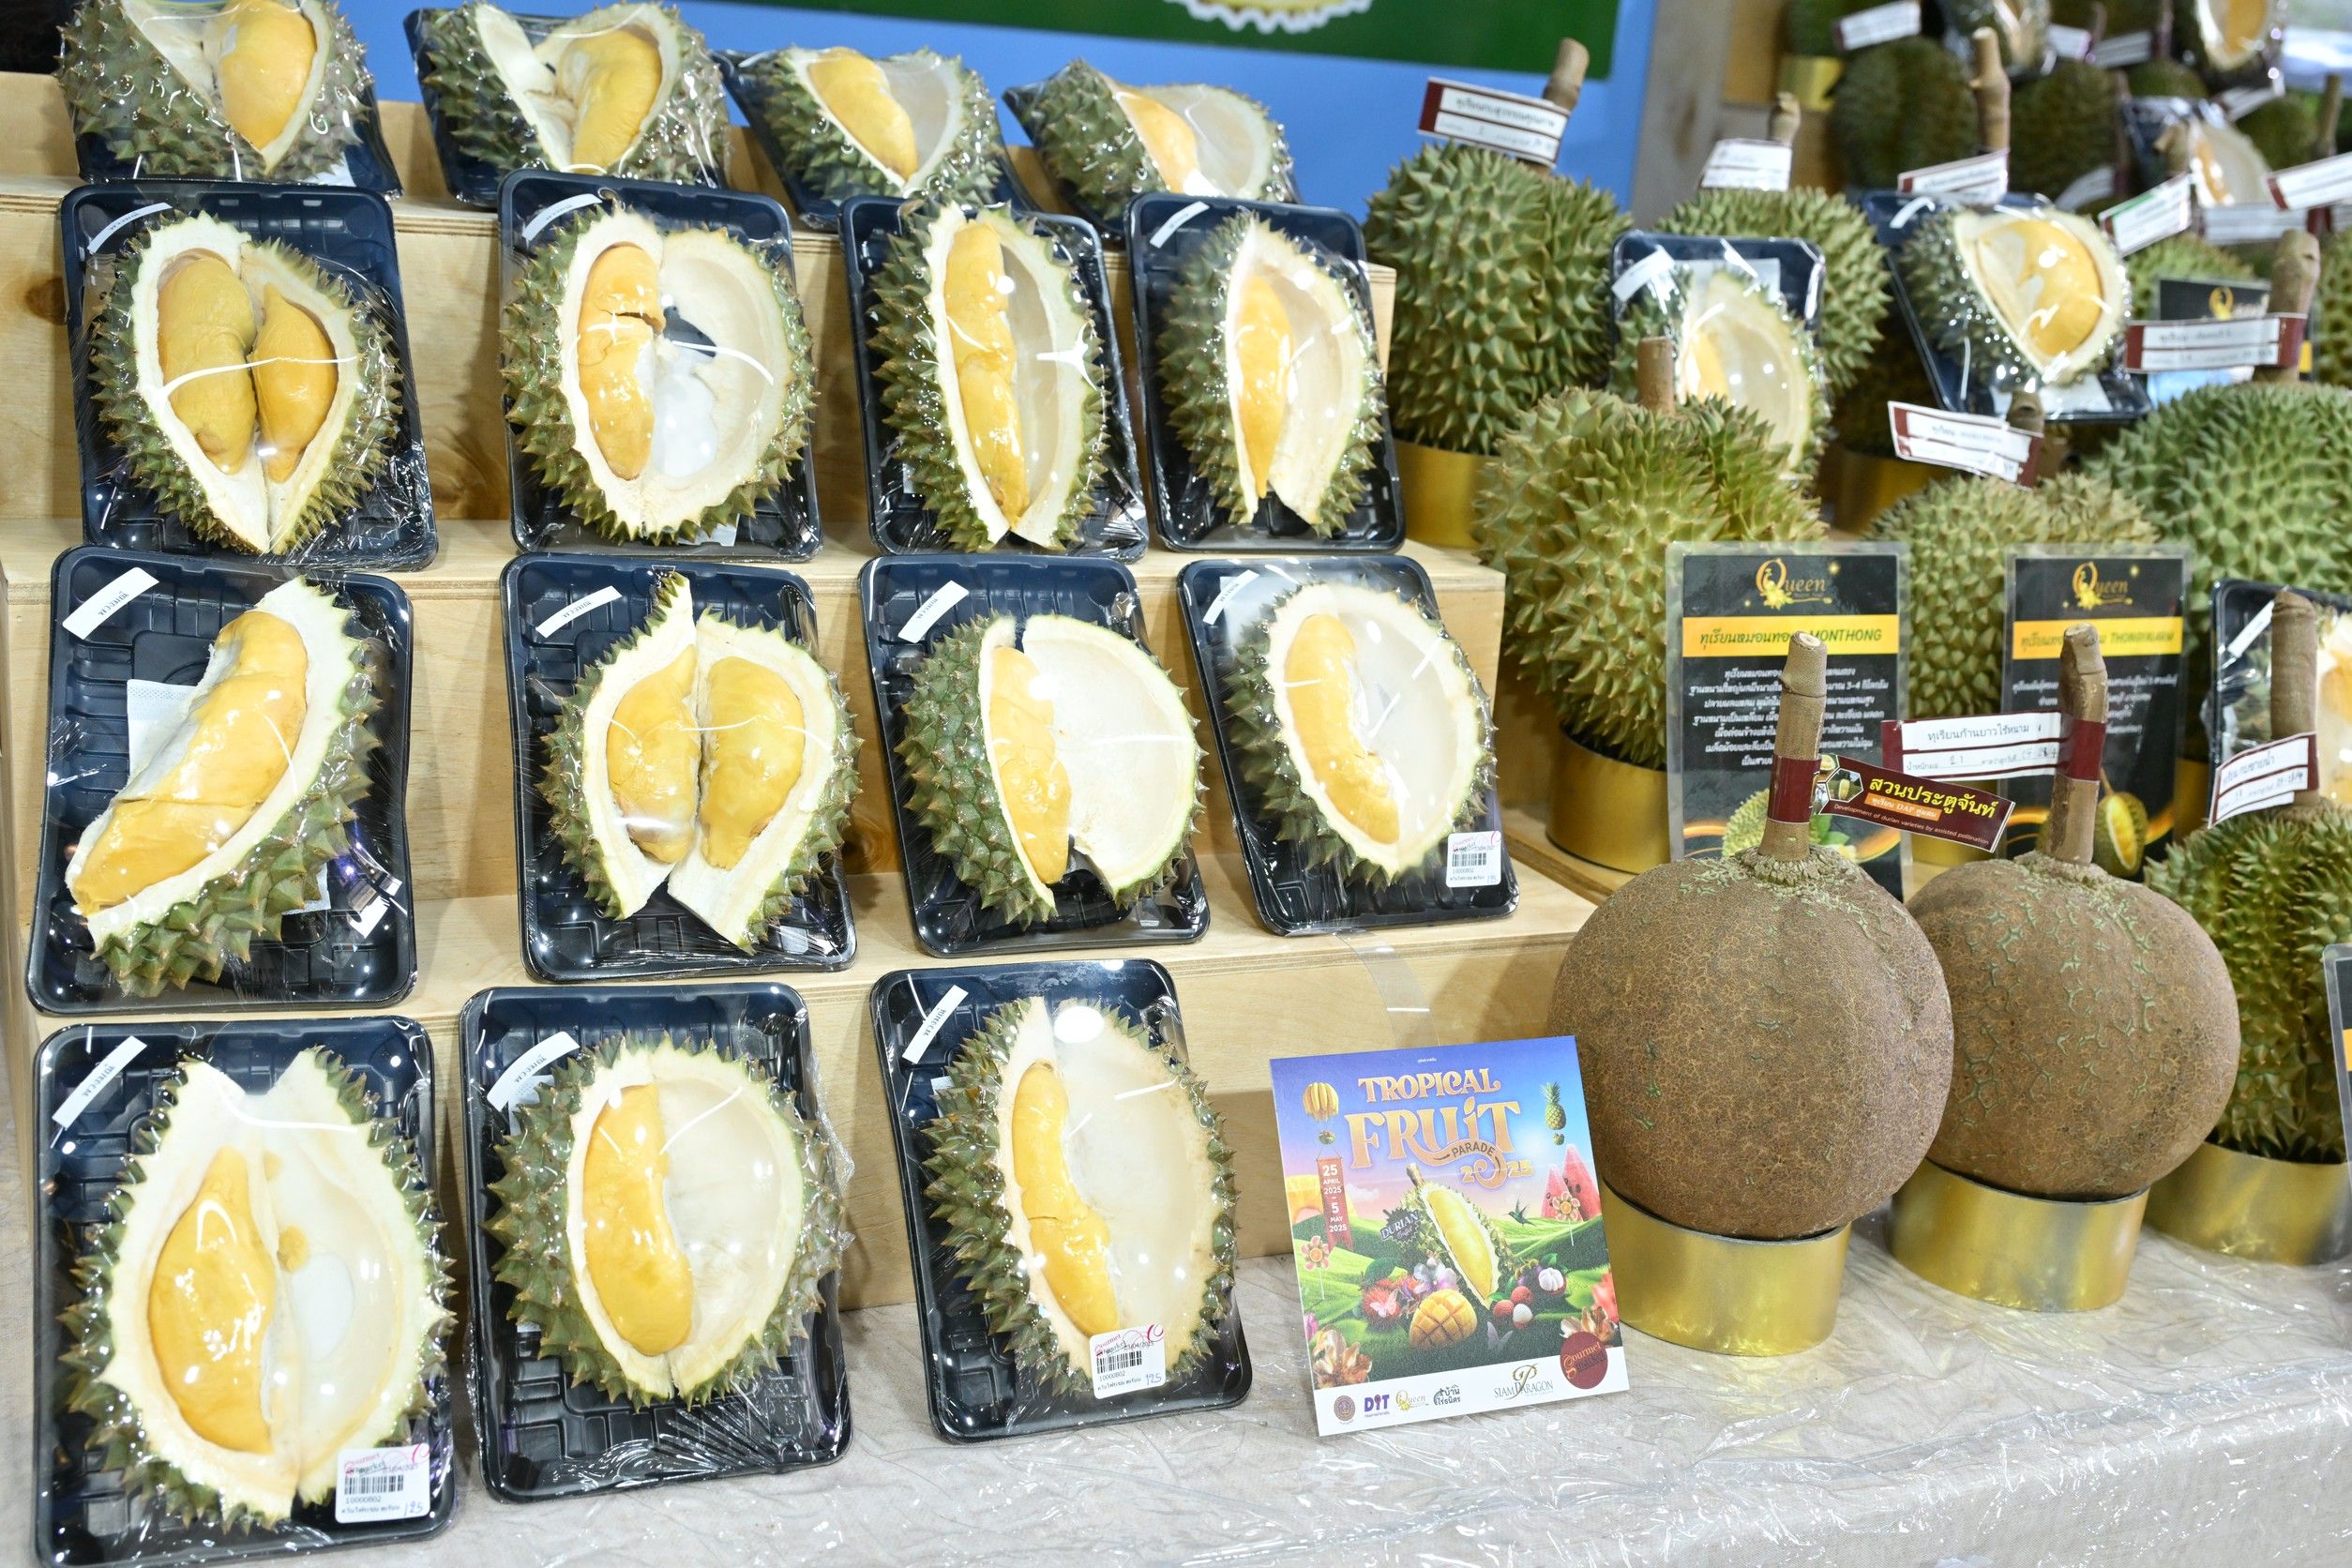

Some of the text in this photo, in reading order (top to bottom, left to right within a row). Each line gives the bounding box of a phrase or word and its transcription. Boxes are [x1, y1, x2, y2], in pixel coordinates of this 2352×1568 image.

[1756, 558, 1826, 605] Queen
[1699, 627, 1789, 650] ทุเรียนหมอนทอ
[1869, 778, 1999, 819] สวนประตูจันท์
[1834, 804, 1873, 818] Development
[1881, 815, 1900, 824] durian
[1901, 820, 1925, 830] varieties
[1934, 826, 1957, 837] assisted
[1957, 832, 1990, 845] pollination
[1358, 1068, 1500, 1103] TROPICAL
[1451, 1142, 1495, 1158] PARADE
[1322, 1164, 1338, 1177] 25
[1461, 1159, 1533, 1188] 2025
[1323, 1186, 1342, 1195] 2025
[1331, 1202, 1339, 1214] 5
[1329, 1224, 1348, 1232] 2025
[1381, 1211, 1419, 1239] DURIAN
[1494, 1386, 1515, 1398] SIAM
[1515, 1380, 1554, 1395] PARAGON
[1395, 1390, 1426, 1410] Queen
